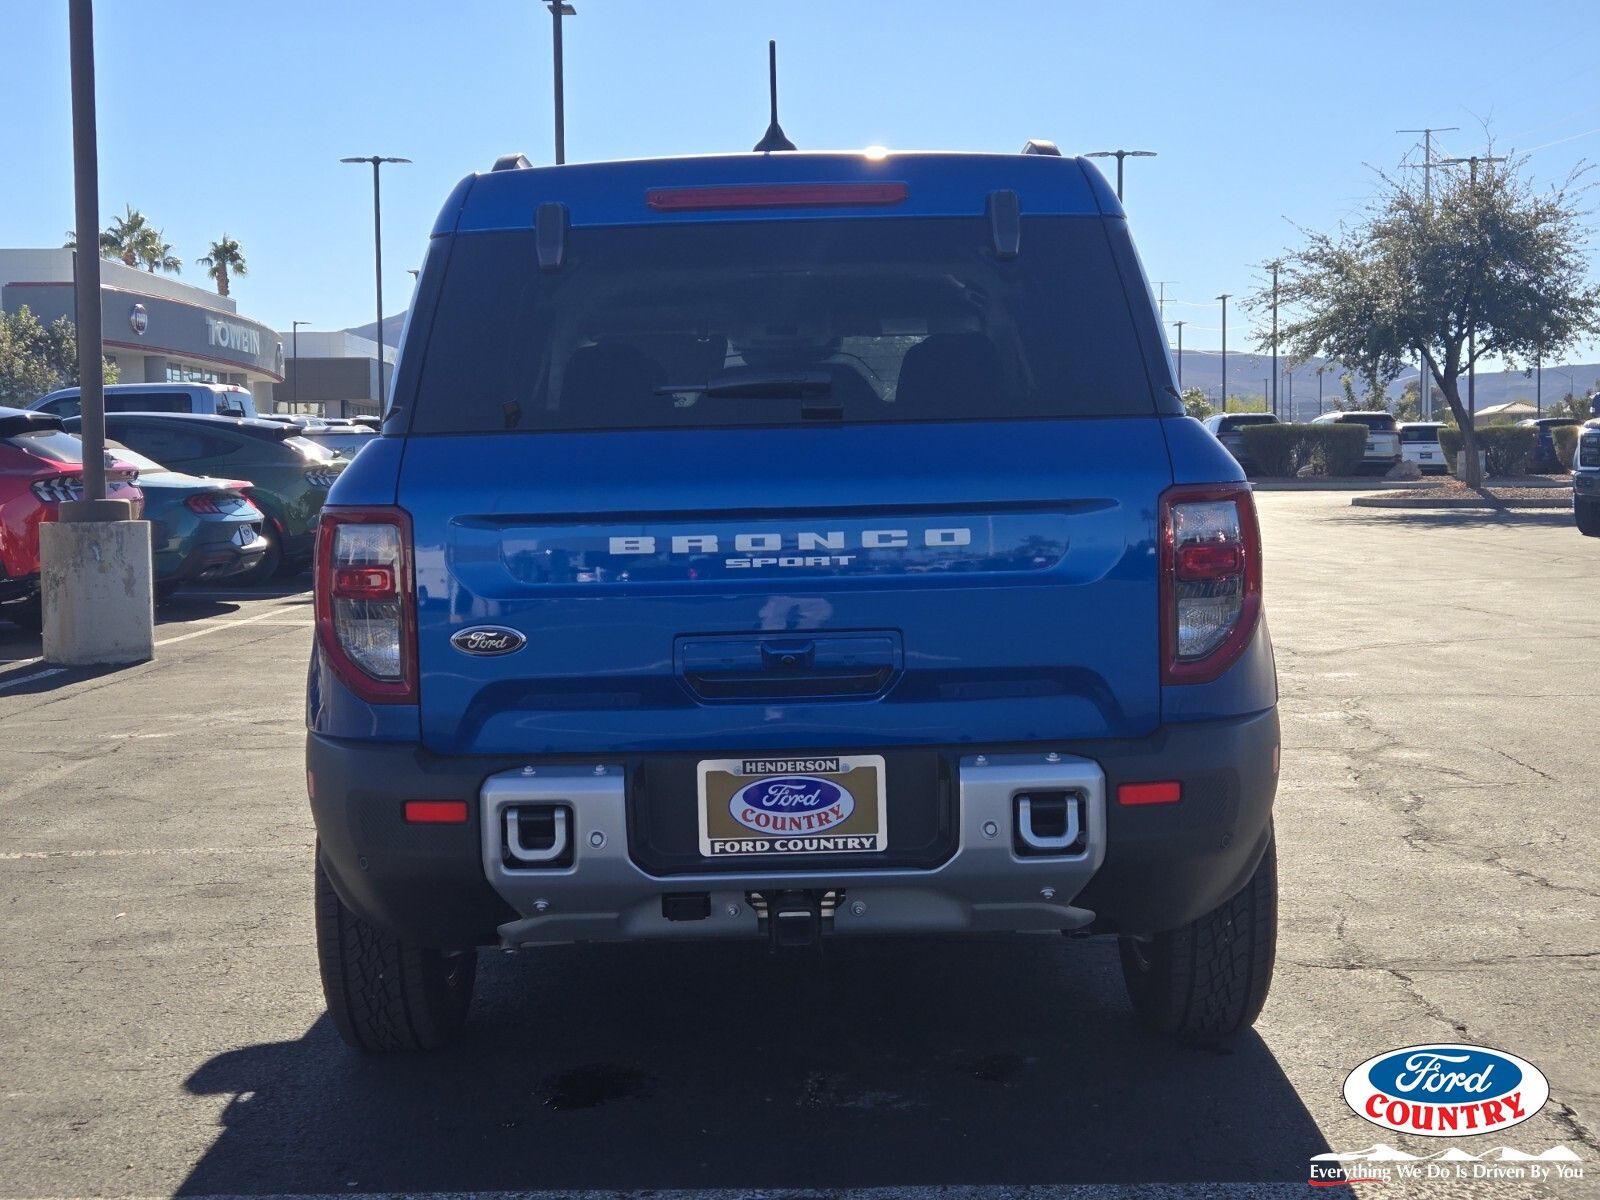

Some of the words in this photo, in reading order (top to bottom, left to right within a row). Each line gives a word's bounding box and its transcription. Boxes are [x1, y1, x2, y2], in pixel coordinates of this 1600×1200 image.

[206, 315, 261, 355] TOWBIN
[608, 527, 972, 555] BRONCO
[724, 555, 857, 569] SPORT
[467, 631, 511, 649] Ford
[745, 759, 838, 774] HENDERSON
[762, 783, 822, 807] Ford
[741, 803, 845, 831] COUNTRY
[713, 839, 770, 853] FORD
[774, 837, 875, 852] COUNTRY
